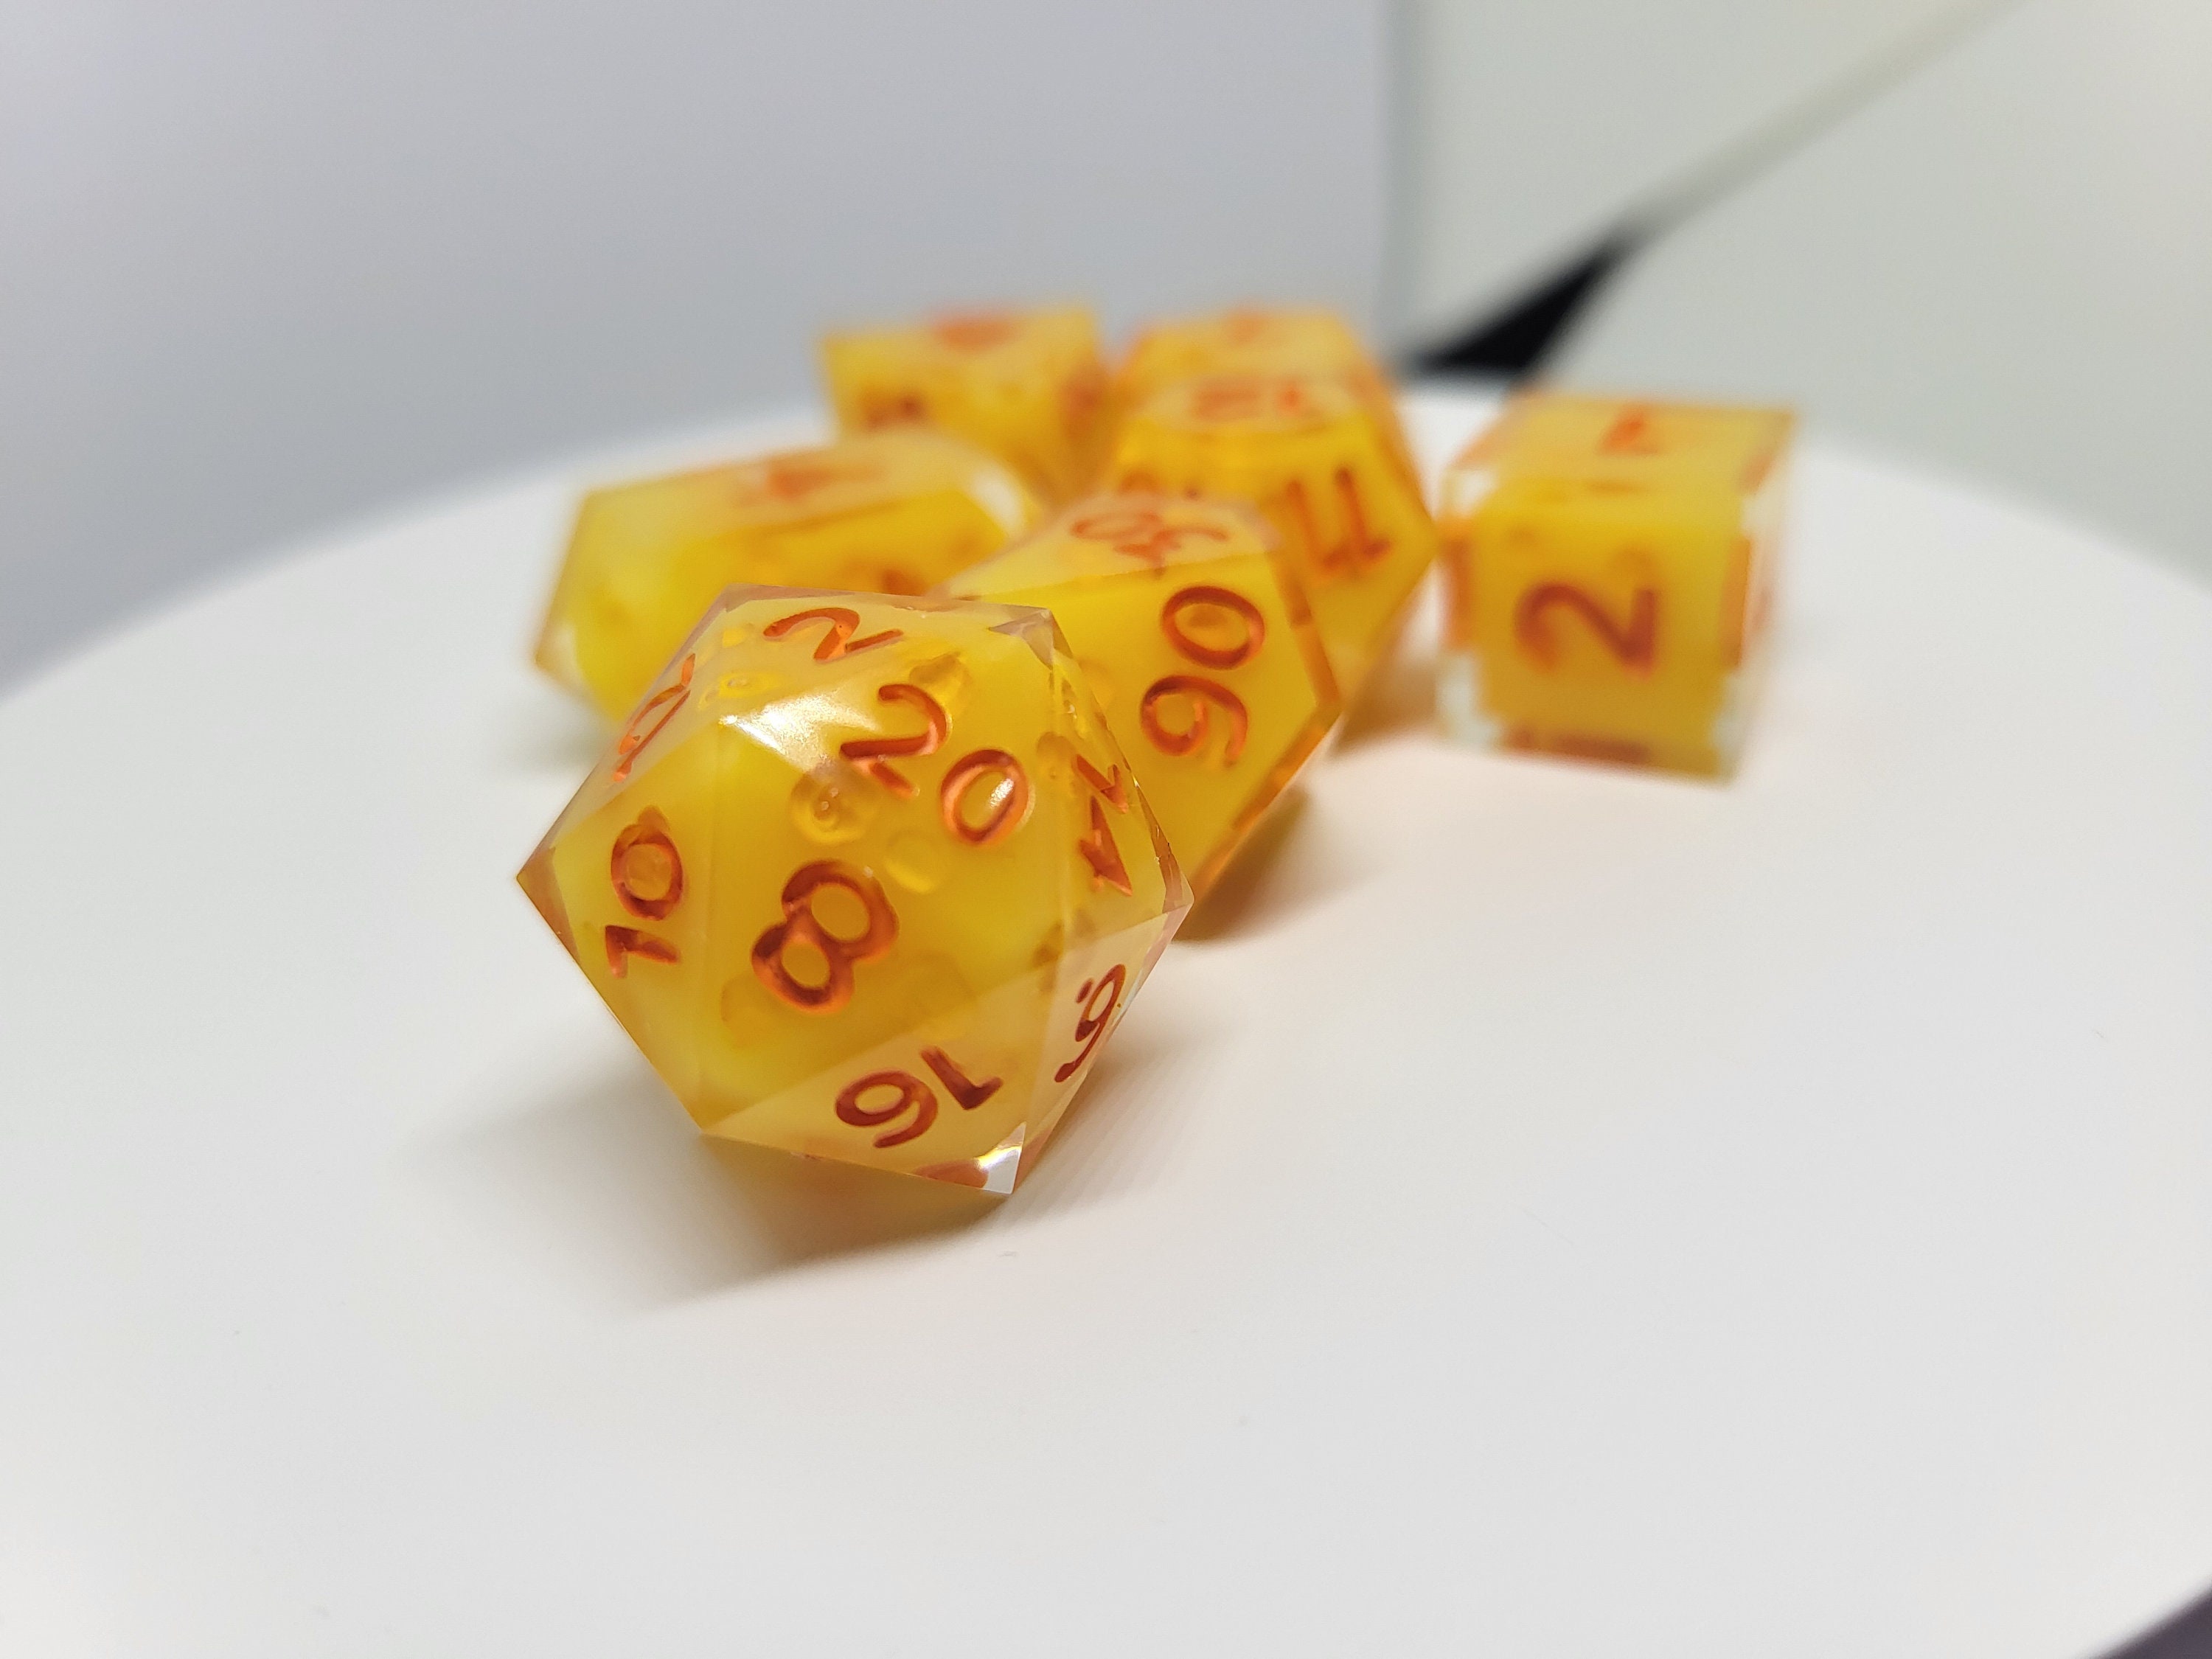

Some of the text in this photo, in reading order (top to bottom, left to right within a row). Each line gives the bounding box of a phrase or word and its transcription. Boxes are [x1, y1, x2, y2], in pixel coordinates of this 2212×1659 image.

[763, 607, 904, 663] 2
[1139, 585, 1265, 765] 90
[1514, 574, 1658, 680] 2
[839, 682, 1029, 848] 20
[605, 815, 684, 978] 10
[751, 857, 900, 1014] 8
[835, 1045, 1004, 1149] 16
